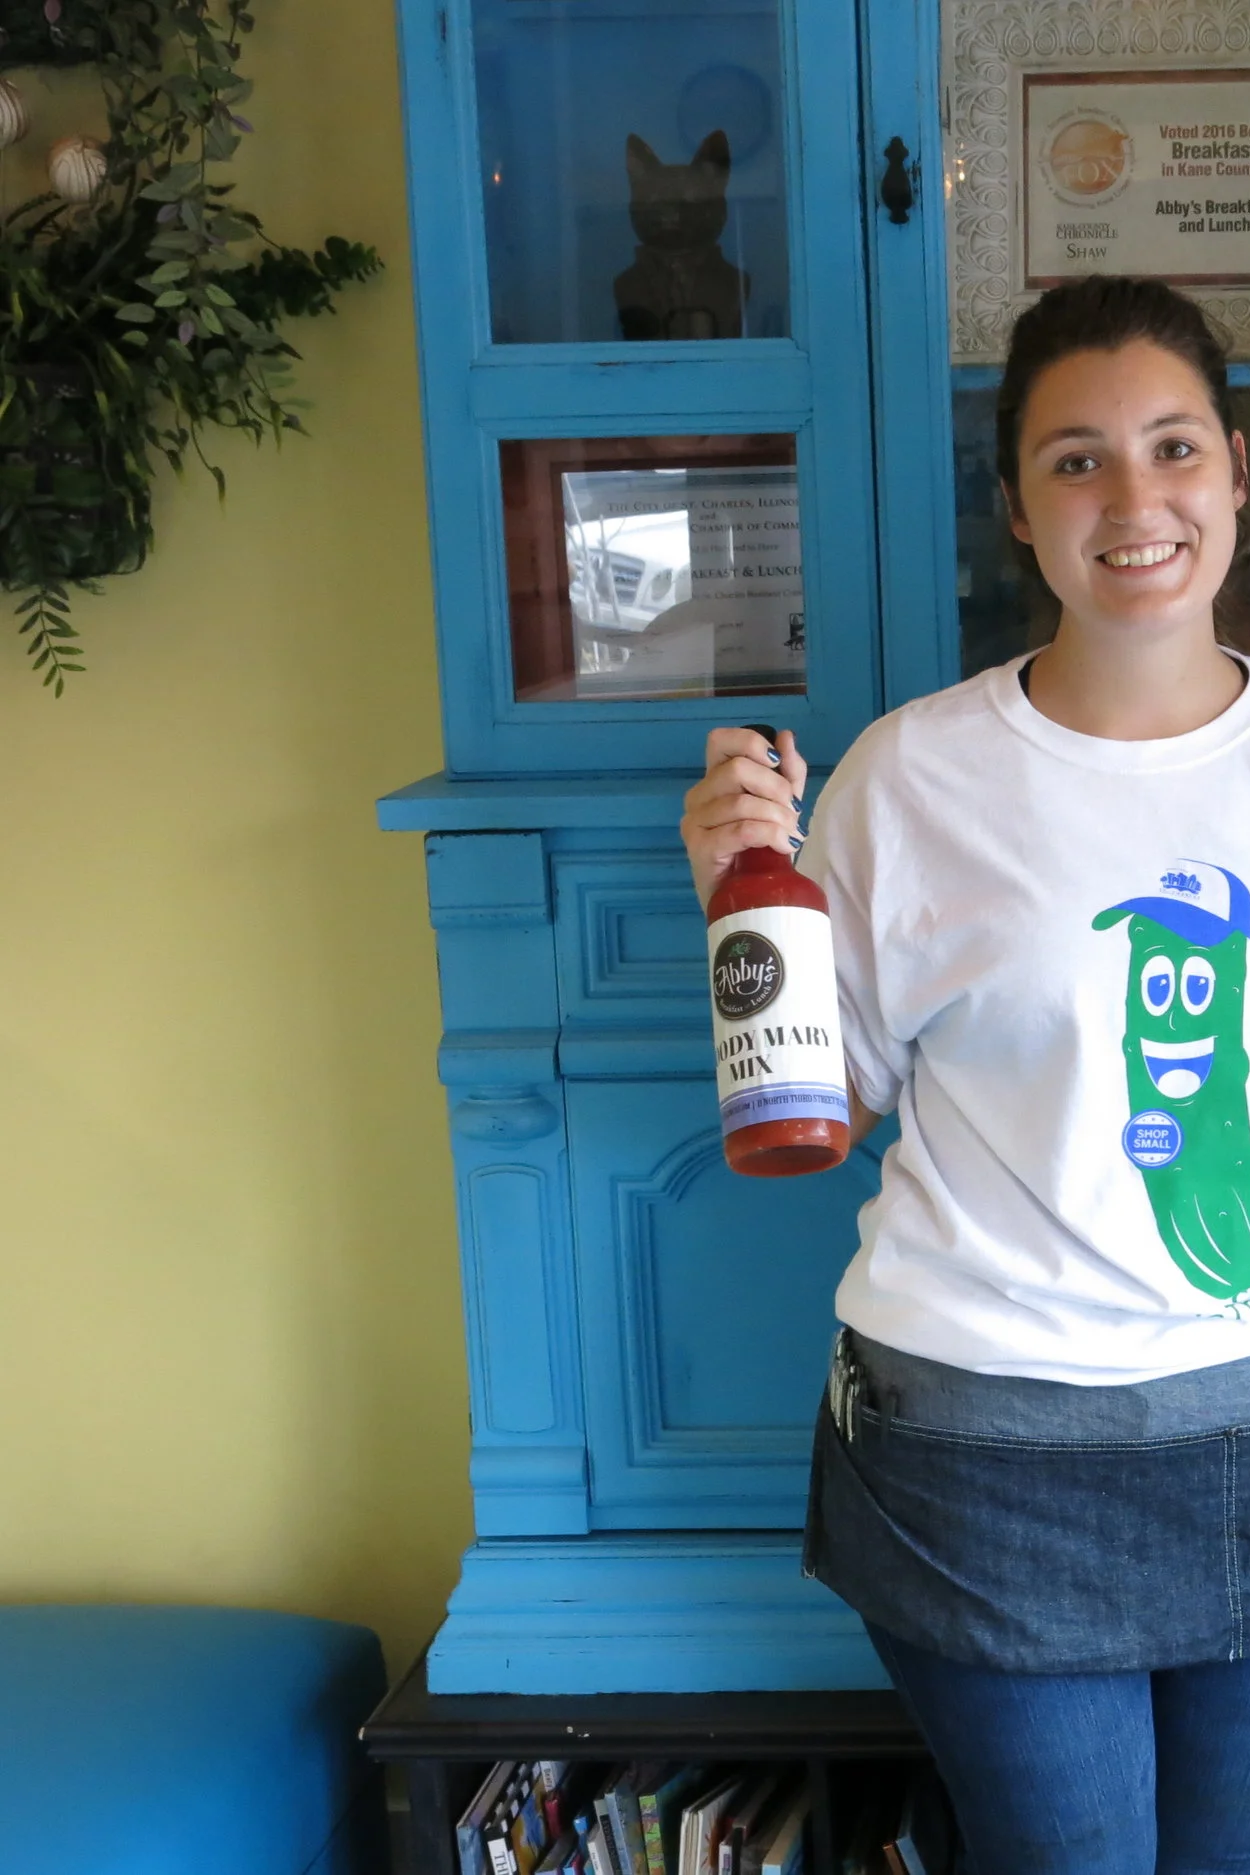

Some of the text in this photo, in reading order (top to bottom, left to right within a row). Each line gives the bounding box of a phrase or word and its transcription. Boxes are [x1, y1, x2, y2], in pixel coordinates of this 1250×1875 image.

[1159, 124, 1198, 139] Voted
[1202, 124, 1235, 139] 2016
[1161, 163, 1174, 177] in
[1178, 162, 1212, 177] Kane
[1155, 200, 1201, 217] Abby's
[1178, 217, 1250, 233] and Lunch
[1066, 243, 1108, 259] SHAW
[714, 956, 779, 996] Abby's
[750, 985, 773, 1006] Lunch
[764, 1026, 830, 1048] MARY
[729, 1055, 773, 1082] MIX
[1136, 1128, 1169, 1139] SHOP
[1133, 1138, 1171, 1149] SMALL
